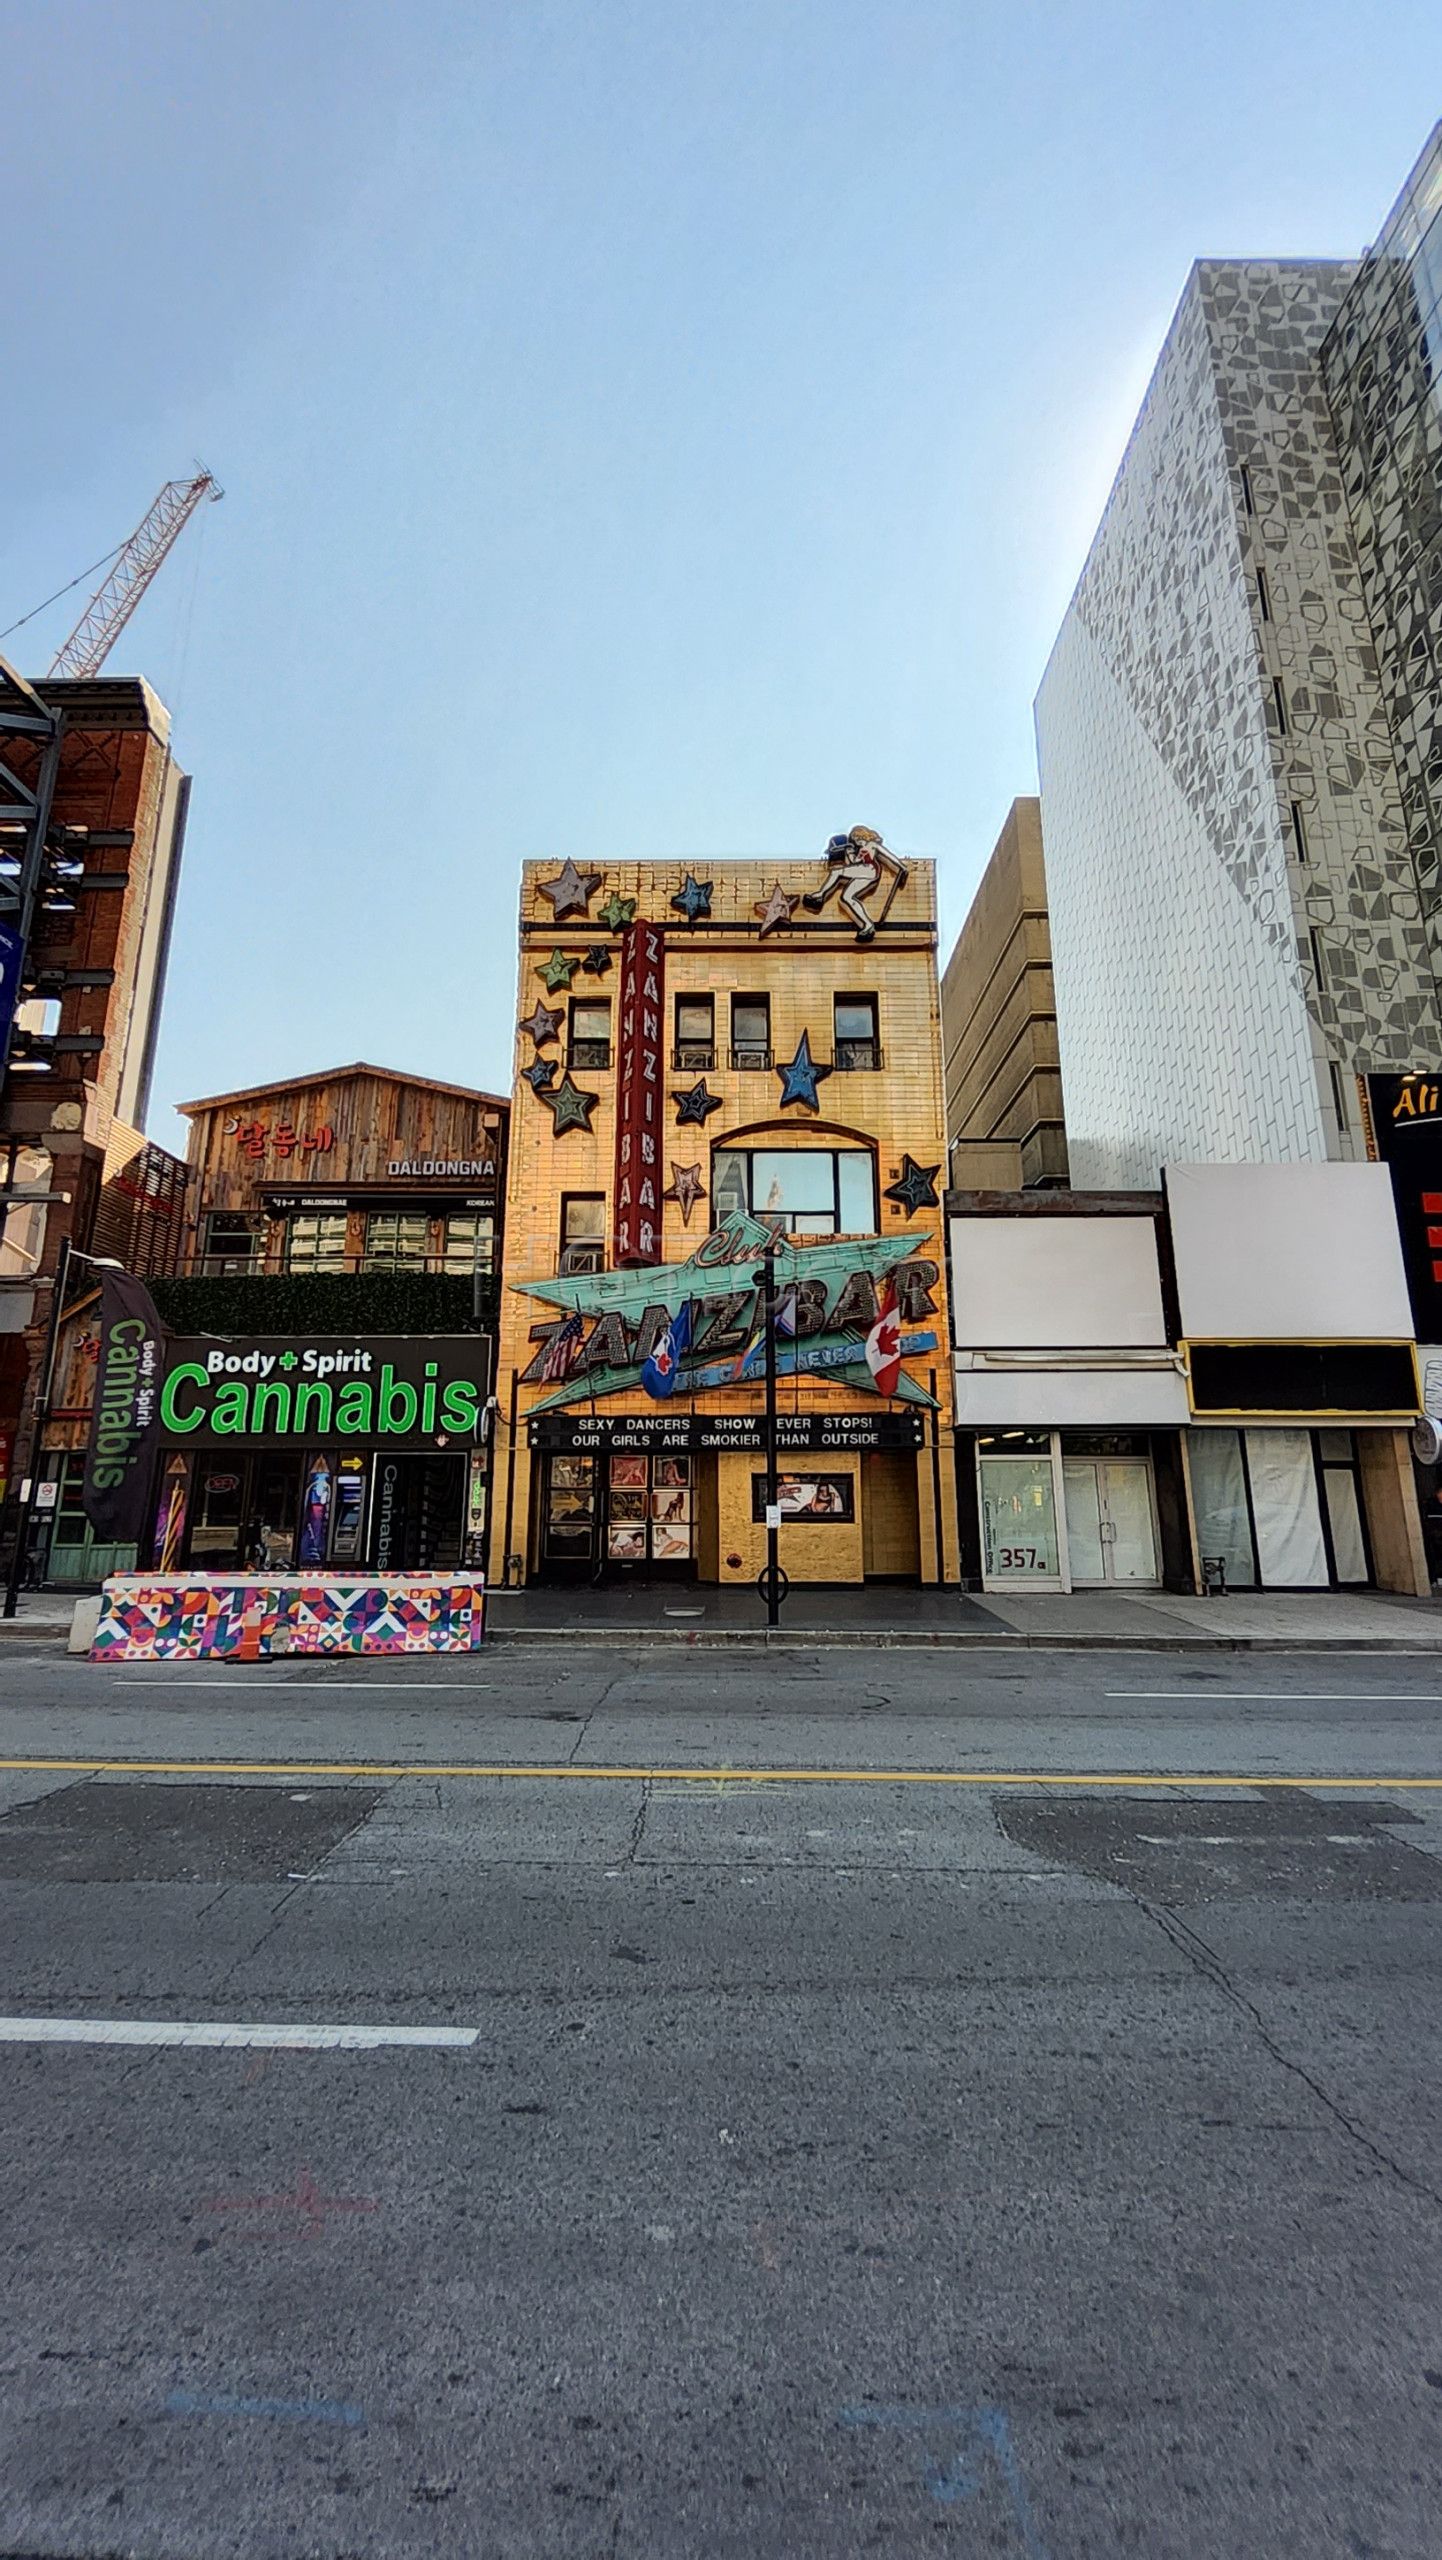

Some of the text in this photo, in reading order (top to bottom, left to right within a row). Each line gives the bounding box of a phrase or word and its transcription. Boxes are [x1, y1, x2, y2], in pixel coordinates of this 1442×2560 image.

[639, 931, 659, 1253] ZANZIBAR
[1393, 1084, 1439, 1118] Ali
[236, 1121, 334, 1158] 달동네
[694, 1223, 785, 1268] Club
[138, 1340, 155, 1376] Body
[207, 1350, 276, 1377] Body
[302, 1349, 373, 1378] Spirit
[92, 1319, 146, 1488] Cannabis
[135, 1389, 154, 1427] Spirit
[160, 1362, 479, 1433] Cannabis
[572, 1433, 880, 1447] OUR GIRLS ARE SMOKIER THAN OUTSIDE
[578, 1417, 873, 1431] SEXY DANCERS SHOW EVER STOPS!
[377, 1465, 398, 1570] Cannabis
